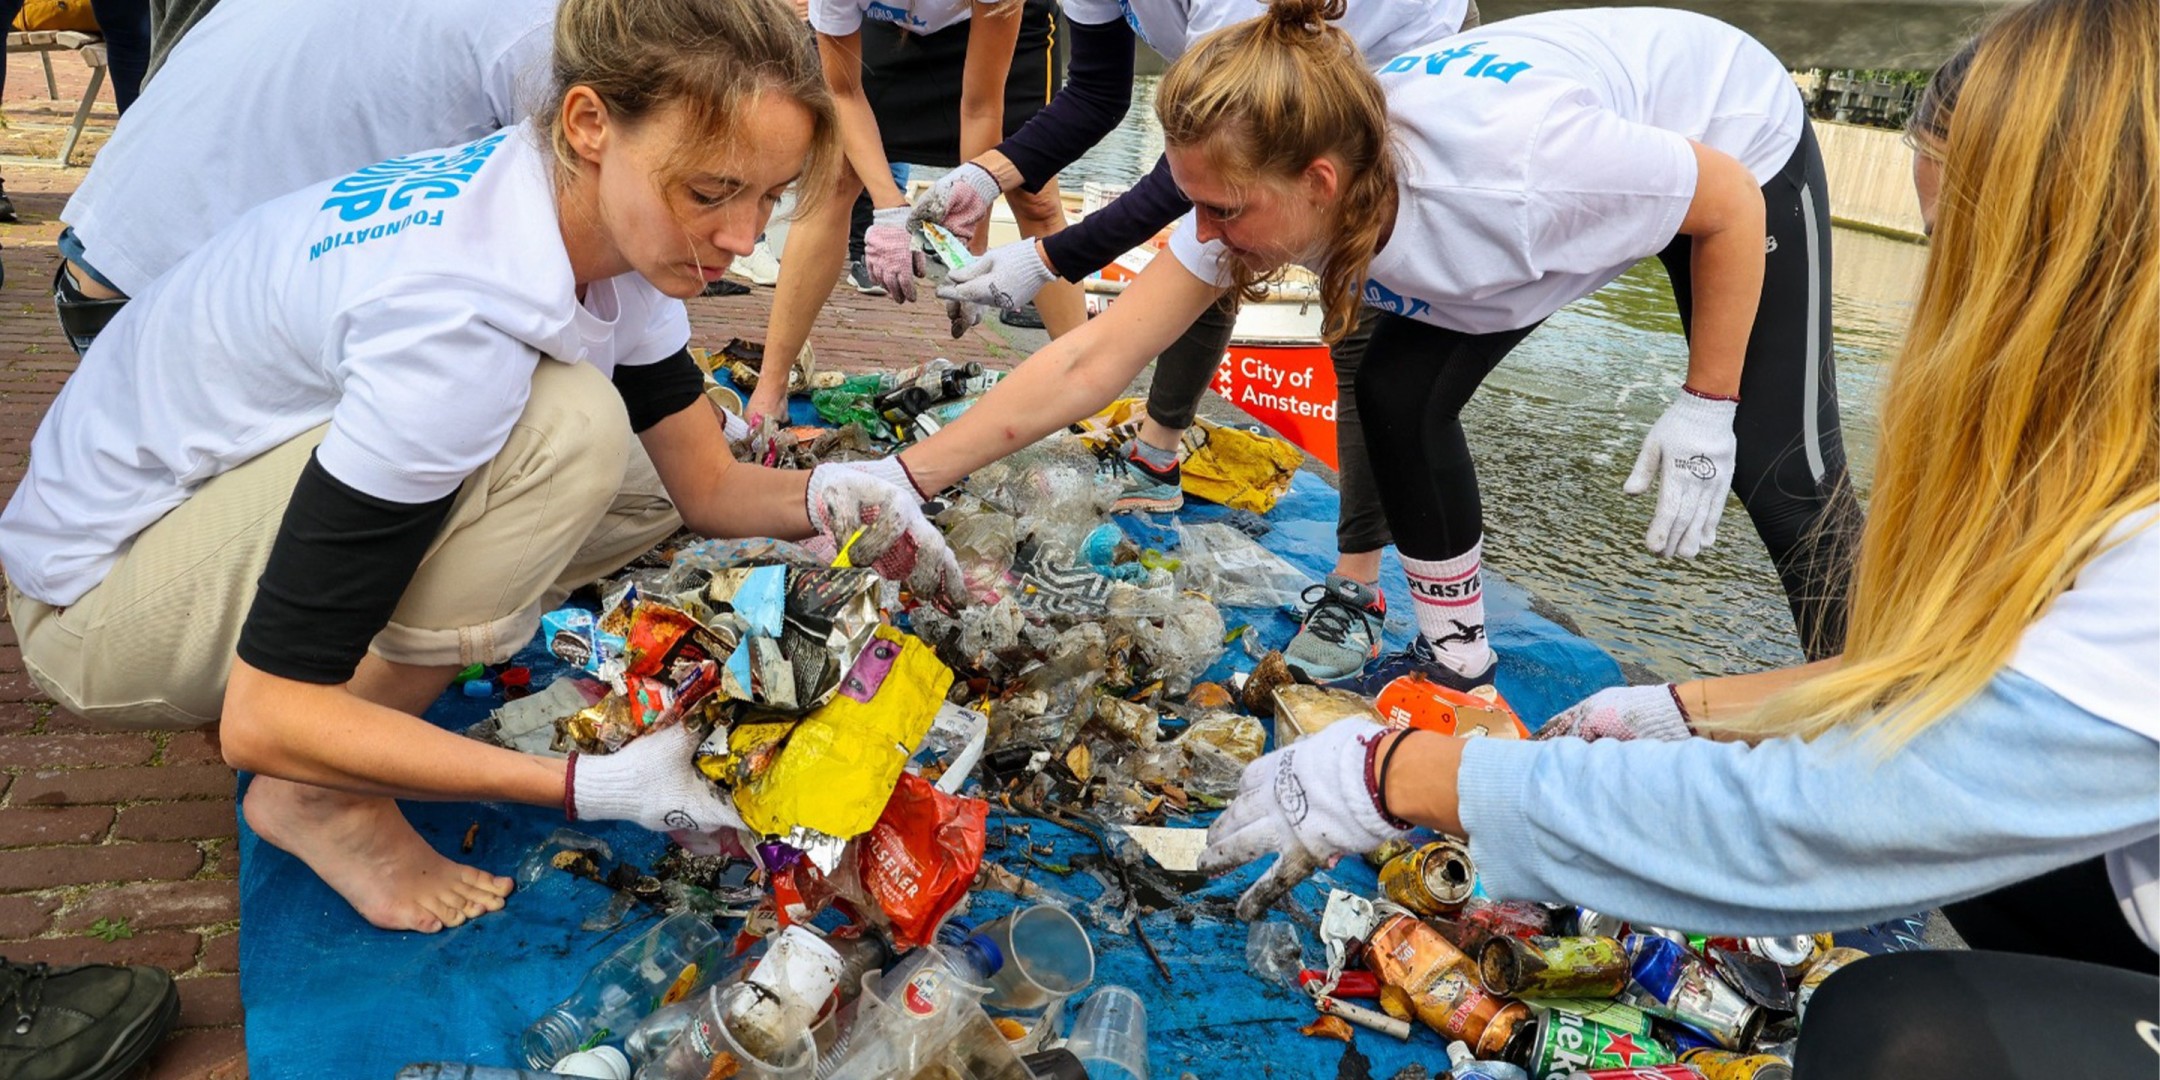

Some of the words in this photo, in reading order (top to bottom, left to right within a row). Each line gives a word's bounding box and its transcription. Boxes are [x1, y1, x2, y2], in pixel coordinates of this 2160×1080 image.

[309, 210, 444, 261] FOUNDATION
[1241, 357, 1285, 389] City
[1289, 367, 1313, 389] of
[1241, 384, 1337, 421] Amsterd
[1407, 573, 1479, 598] PLASTI
